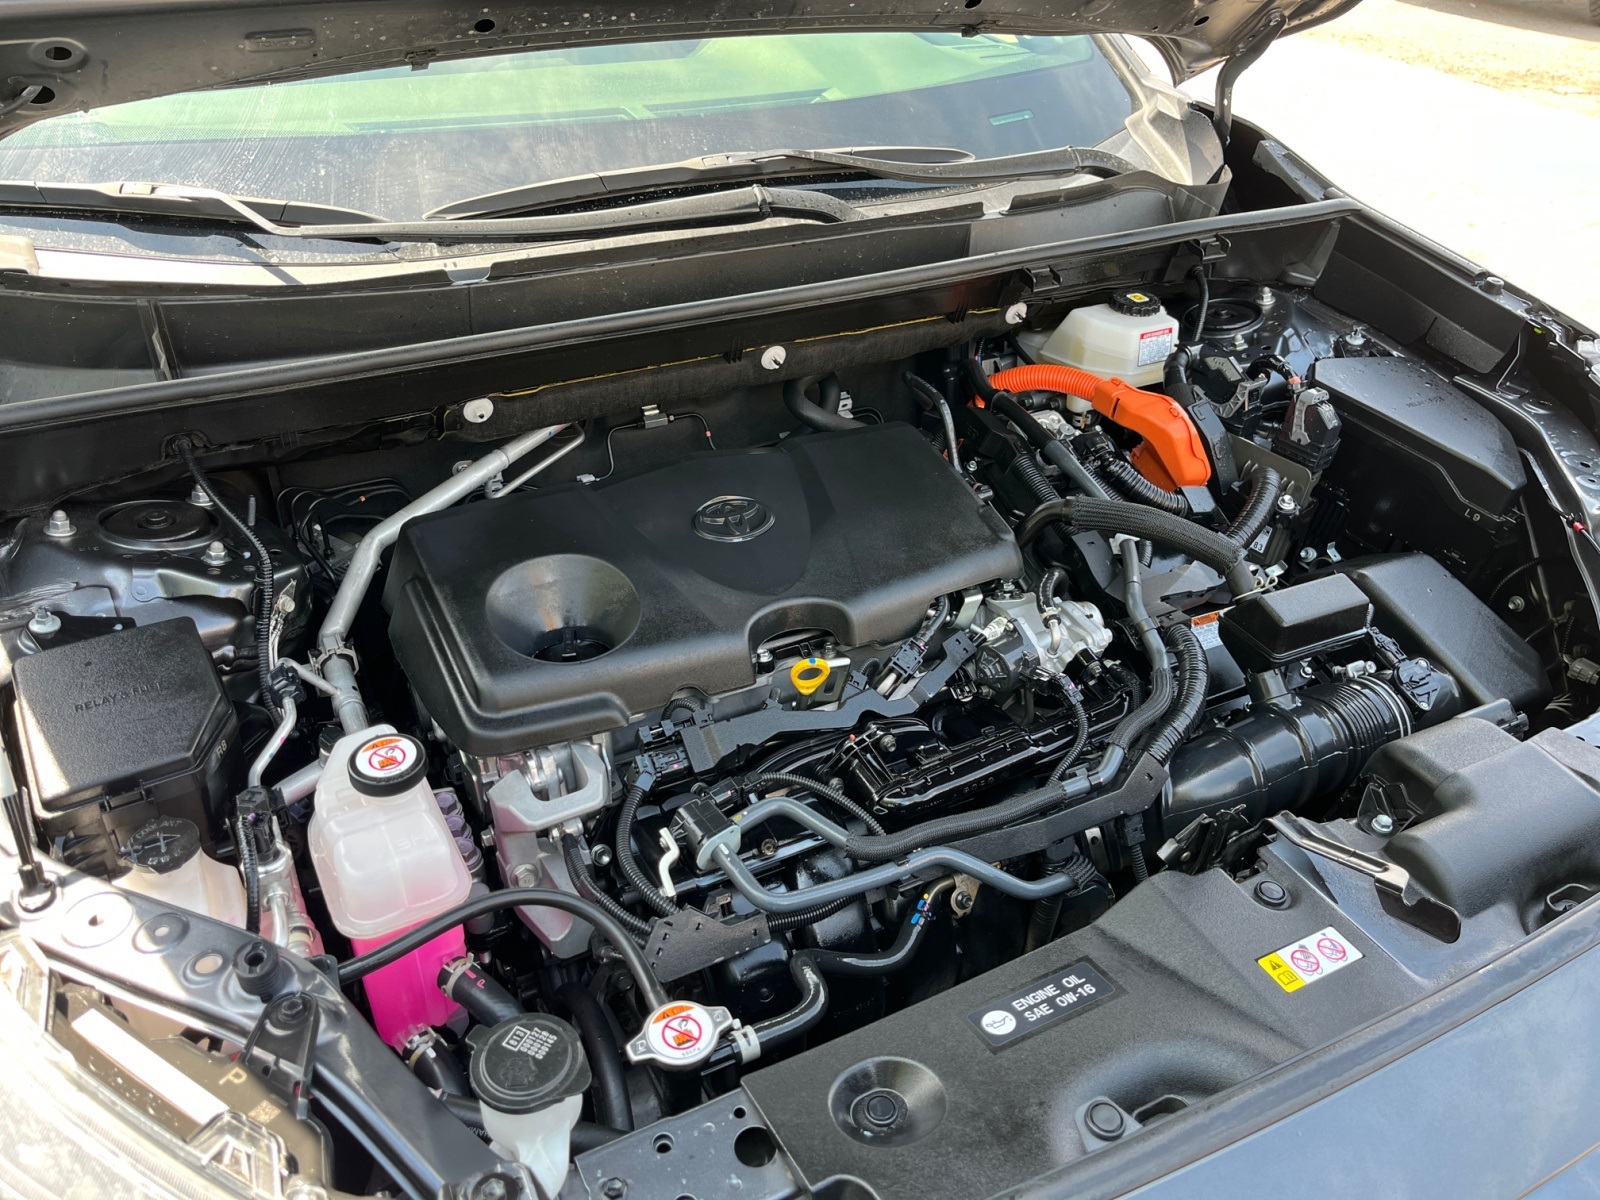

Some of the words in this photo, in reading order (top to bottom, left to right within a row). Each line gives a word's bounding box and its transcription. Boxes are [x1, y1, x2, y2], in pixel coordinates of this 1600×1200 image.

[73, 693, 117, 713] RELAY
[1011, 984, 1061, 1012] ENGINE
[1061, 974, 1086, 988] OIL
[1024, 1003, 1055, 1022] SAE
[1055, 983, 1097, 1007] 0W-16
[218, 1066, 248, 1085] P
